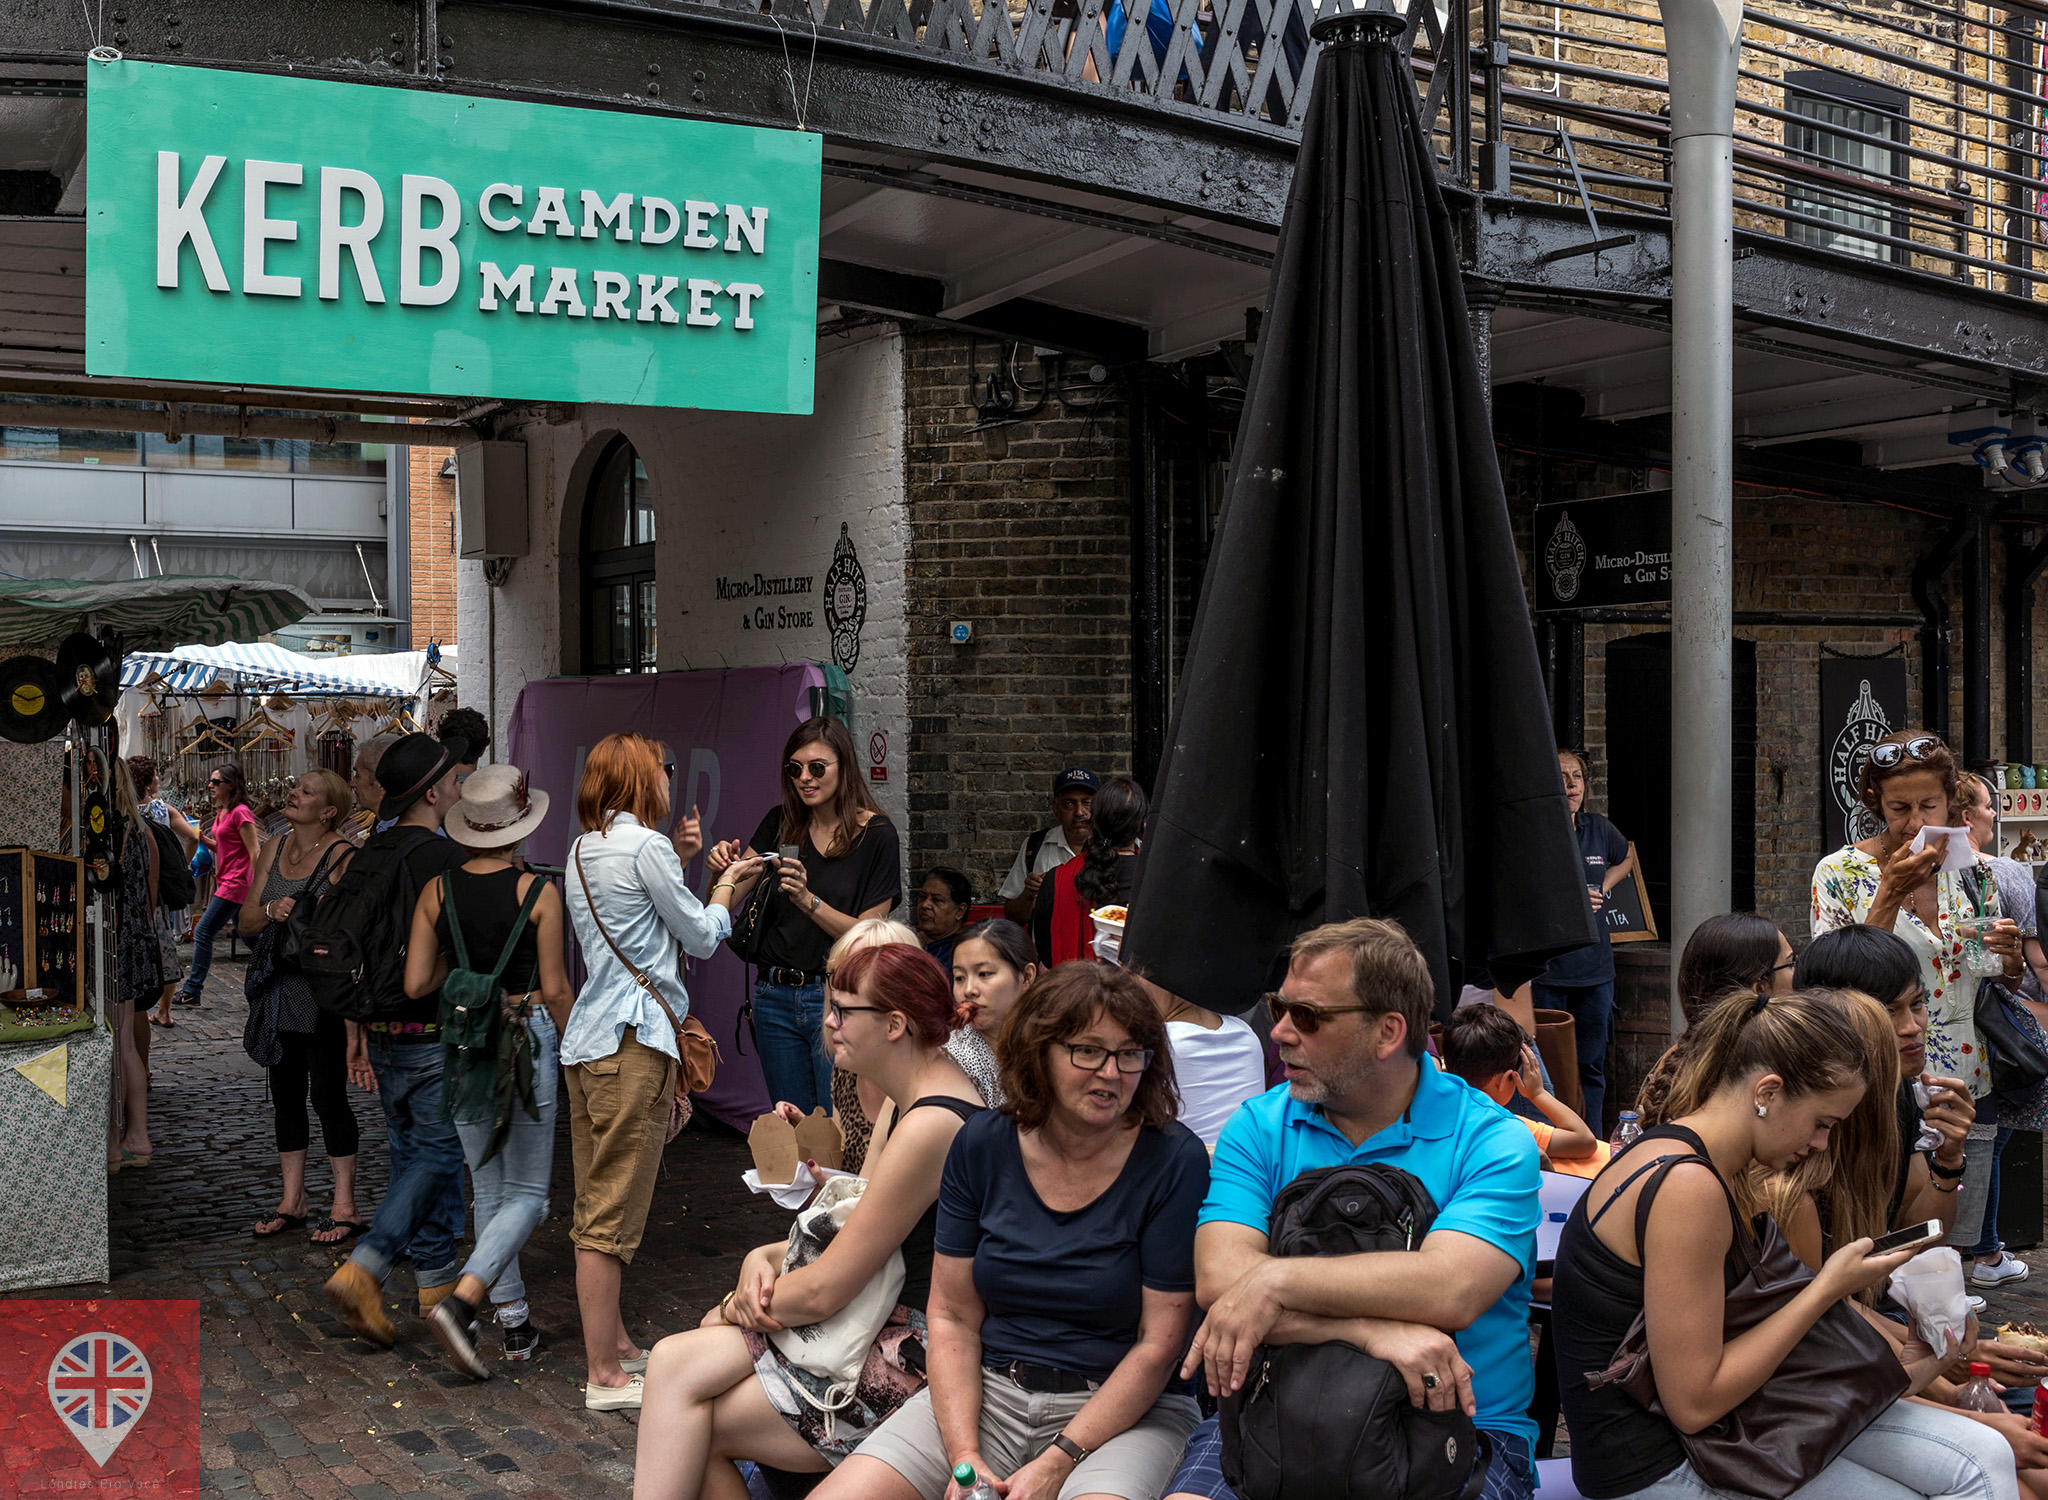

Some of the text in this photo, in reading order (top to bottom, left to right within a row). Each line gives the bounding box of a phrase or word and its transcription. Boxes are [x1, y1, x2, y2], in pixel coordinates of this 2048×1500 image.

[156, 150, 462, 308] KERB
[478, 183, 770, 255] CAMDEN
[478, 261, 766, 331] MARKET
[1547, 532, 1585, 563] HALF HITCH
[825, 557, 866, 610] HALF HITCH
[838, 594, 851, 604] GIN
[1623, 573, 1632, 584] &
[742, 613, 752, 630] &
[1834, 723, 1861, 783] HALF
[1067, 770, 1090, 780] NIKE
